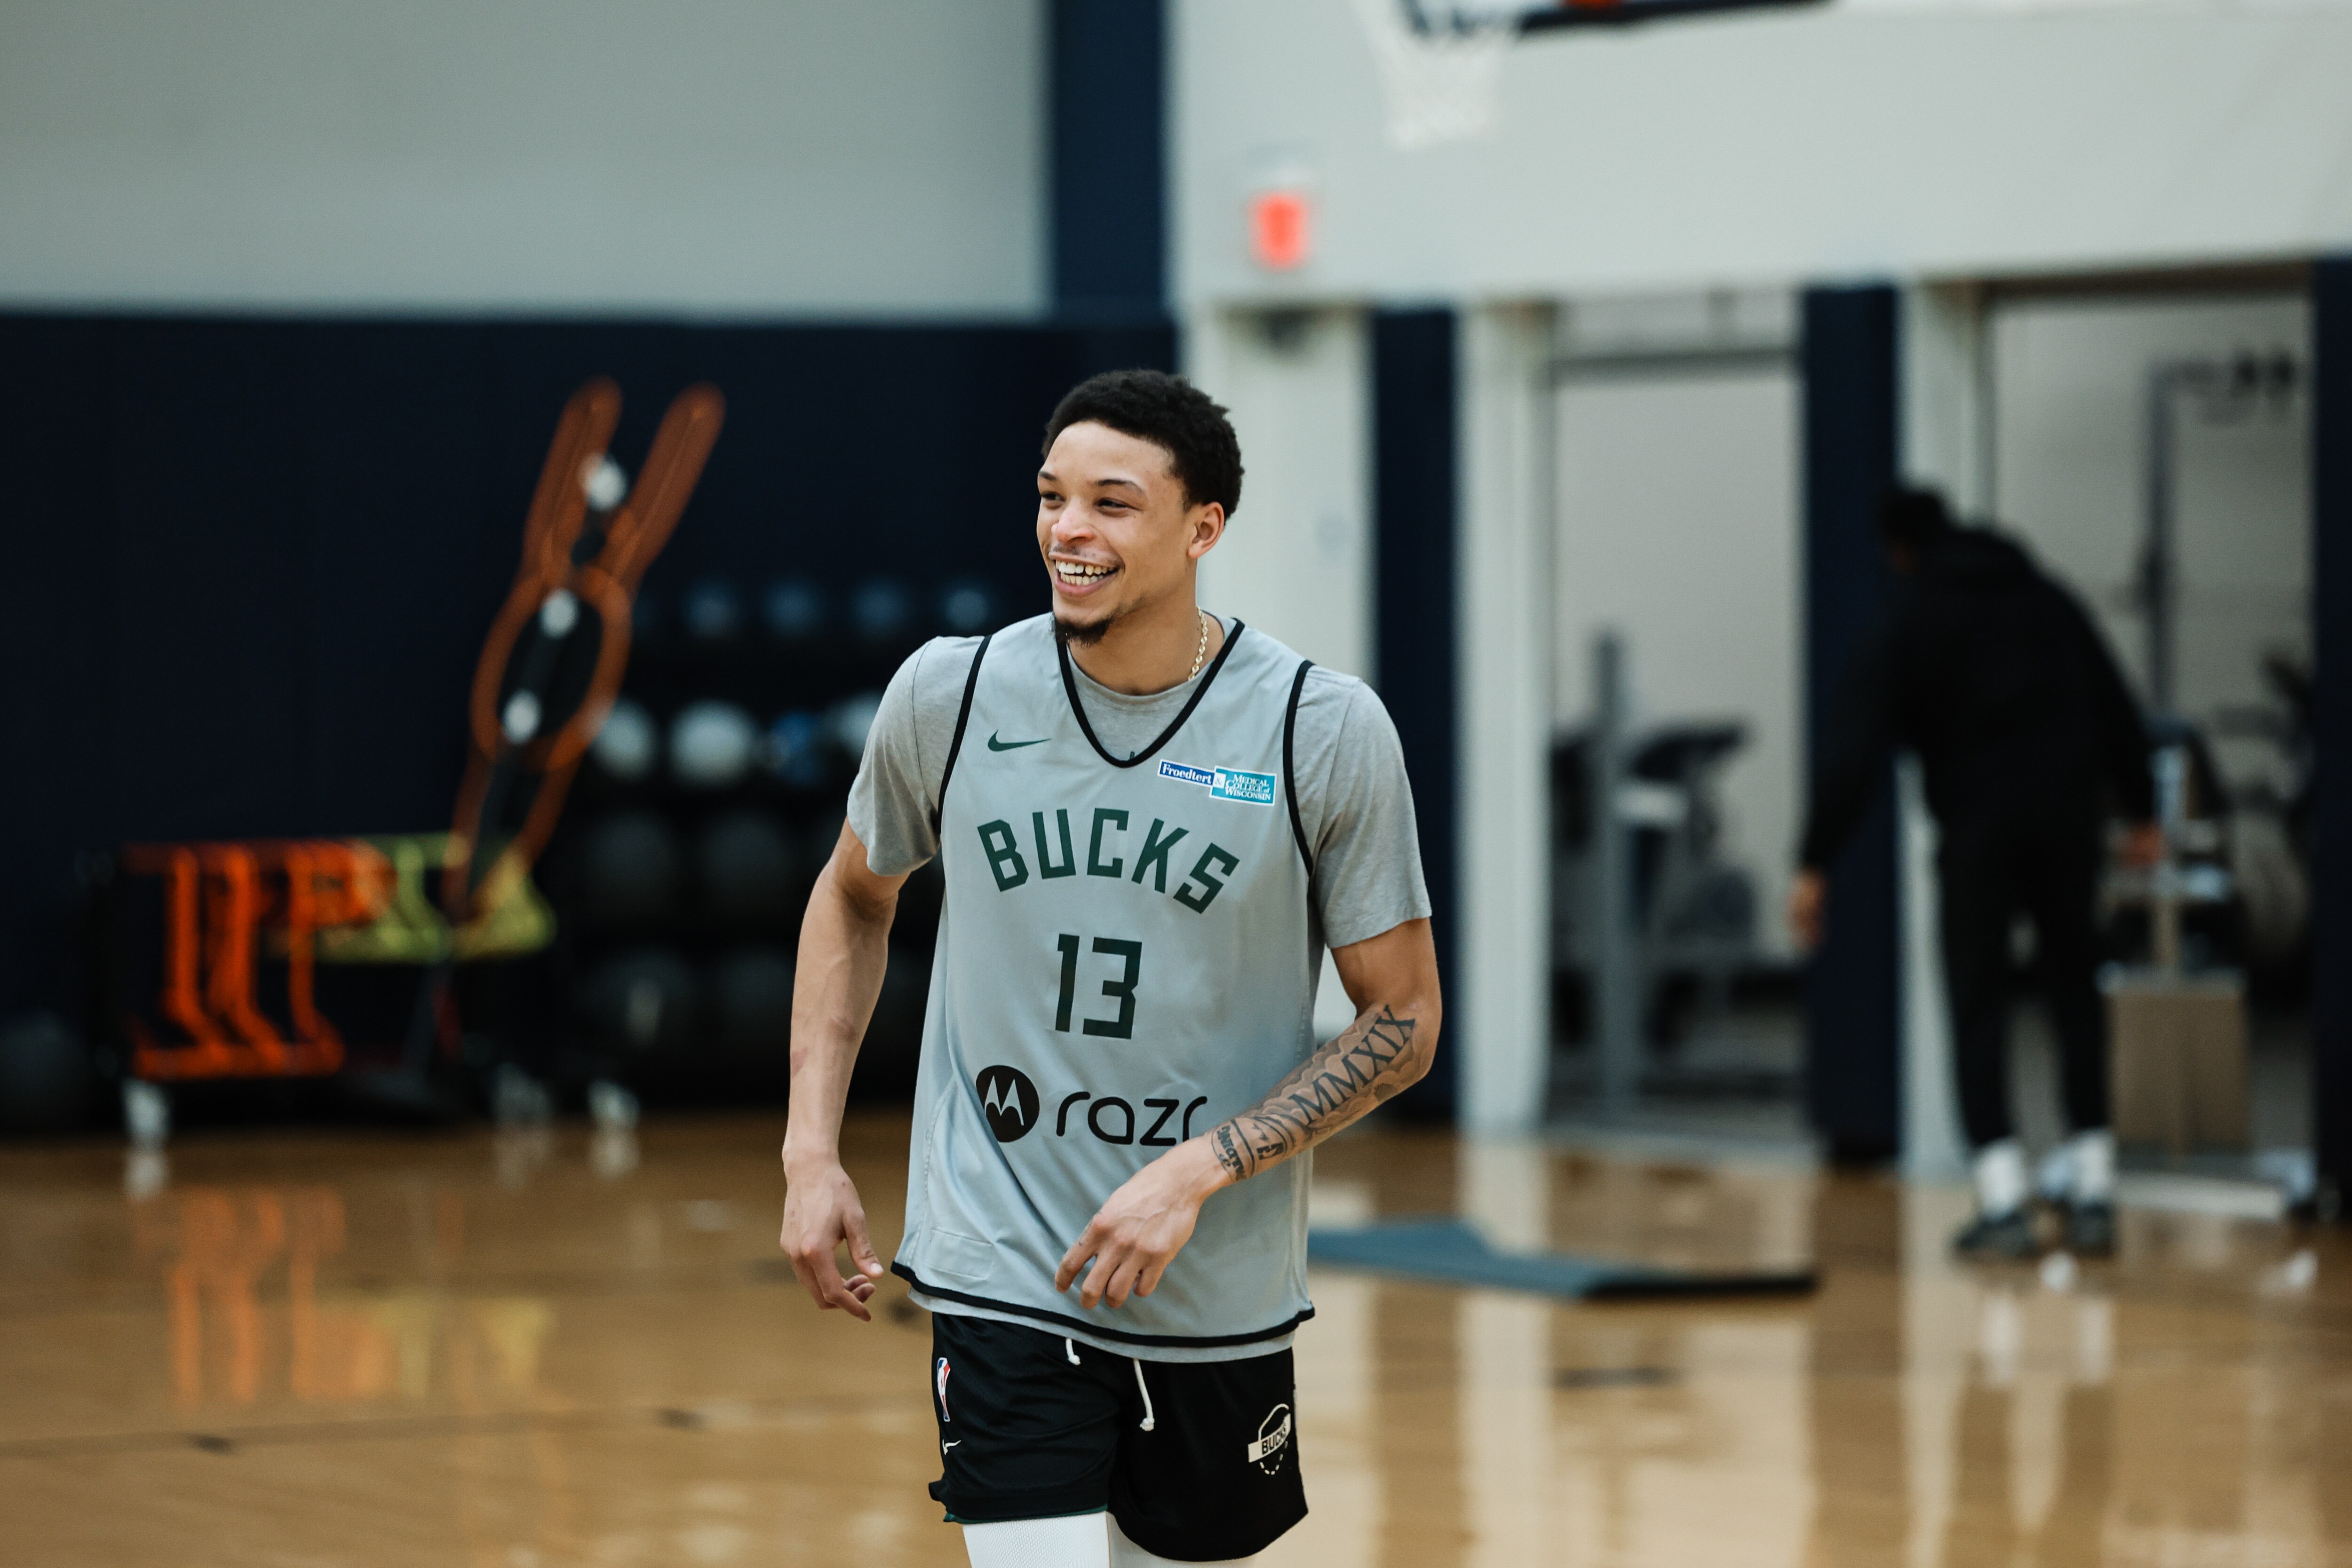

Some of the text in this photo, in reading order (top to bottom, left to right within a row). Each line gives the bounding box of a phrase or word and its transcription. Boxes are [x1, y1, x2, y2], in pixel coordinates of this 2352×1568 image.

[1162, 763, 1224, 785] Froedtert &
[1225, 780, 1262, 793] COLLEGE
[1225, 786, 1271, 800] WISCONSIN
[1233, 774, 1269, 787] MEDICAL
[977, 808, 1240, 914] BUCKS
[1055, 934, 1143, 1039] 13
[1287, 1004, 1415, 1125] MMXIX
[1056, 1091, 1208, 1146] razr
